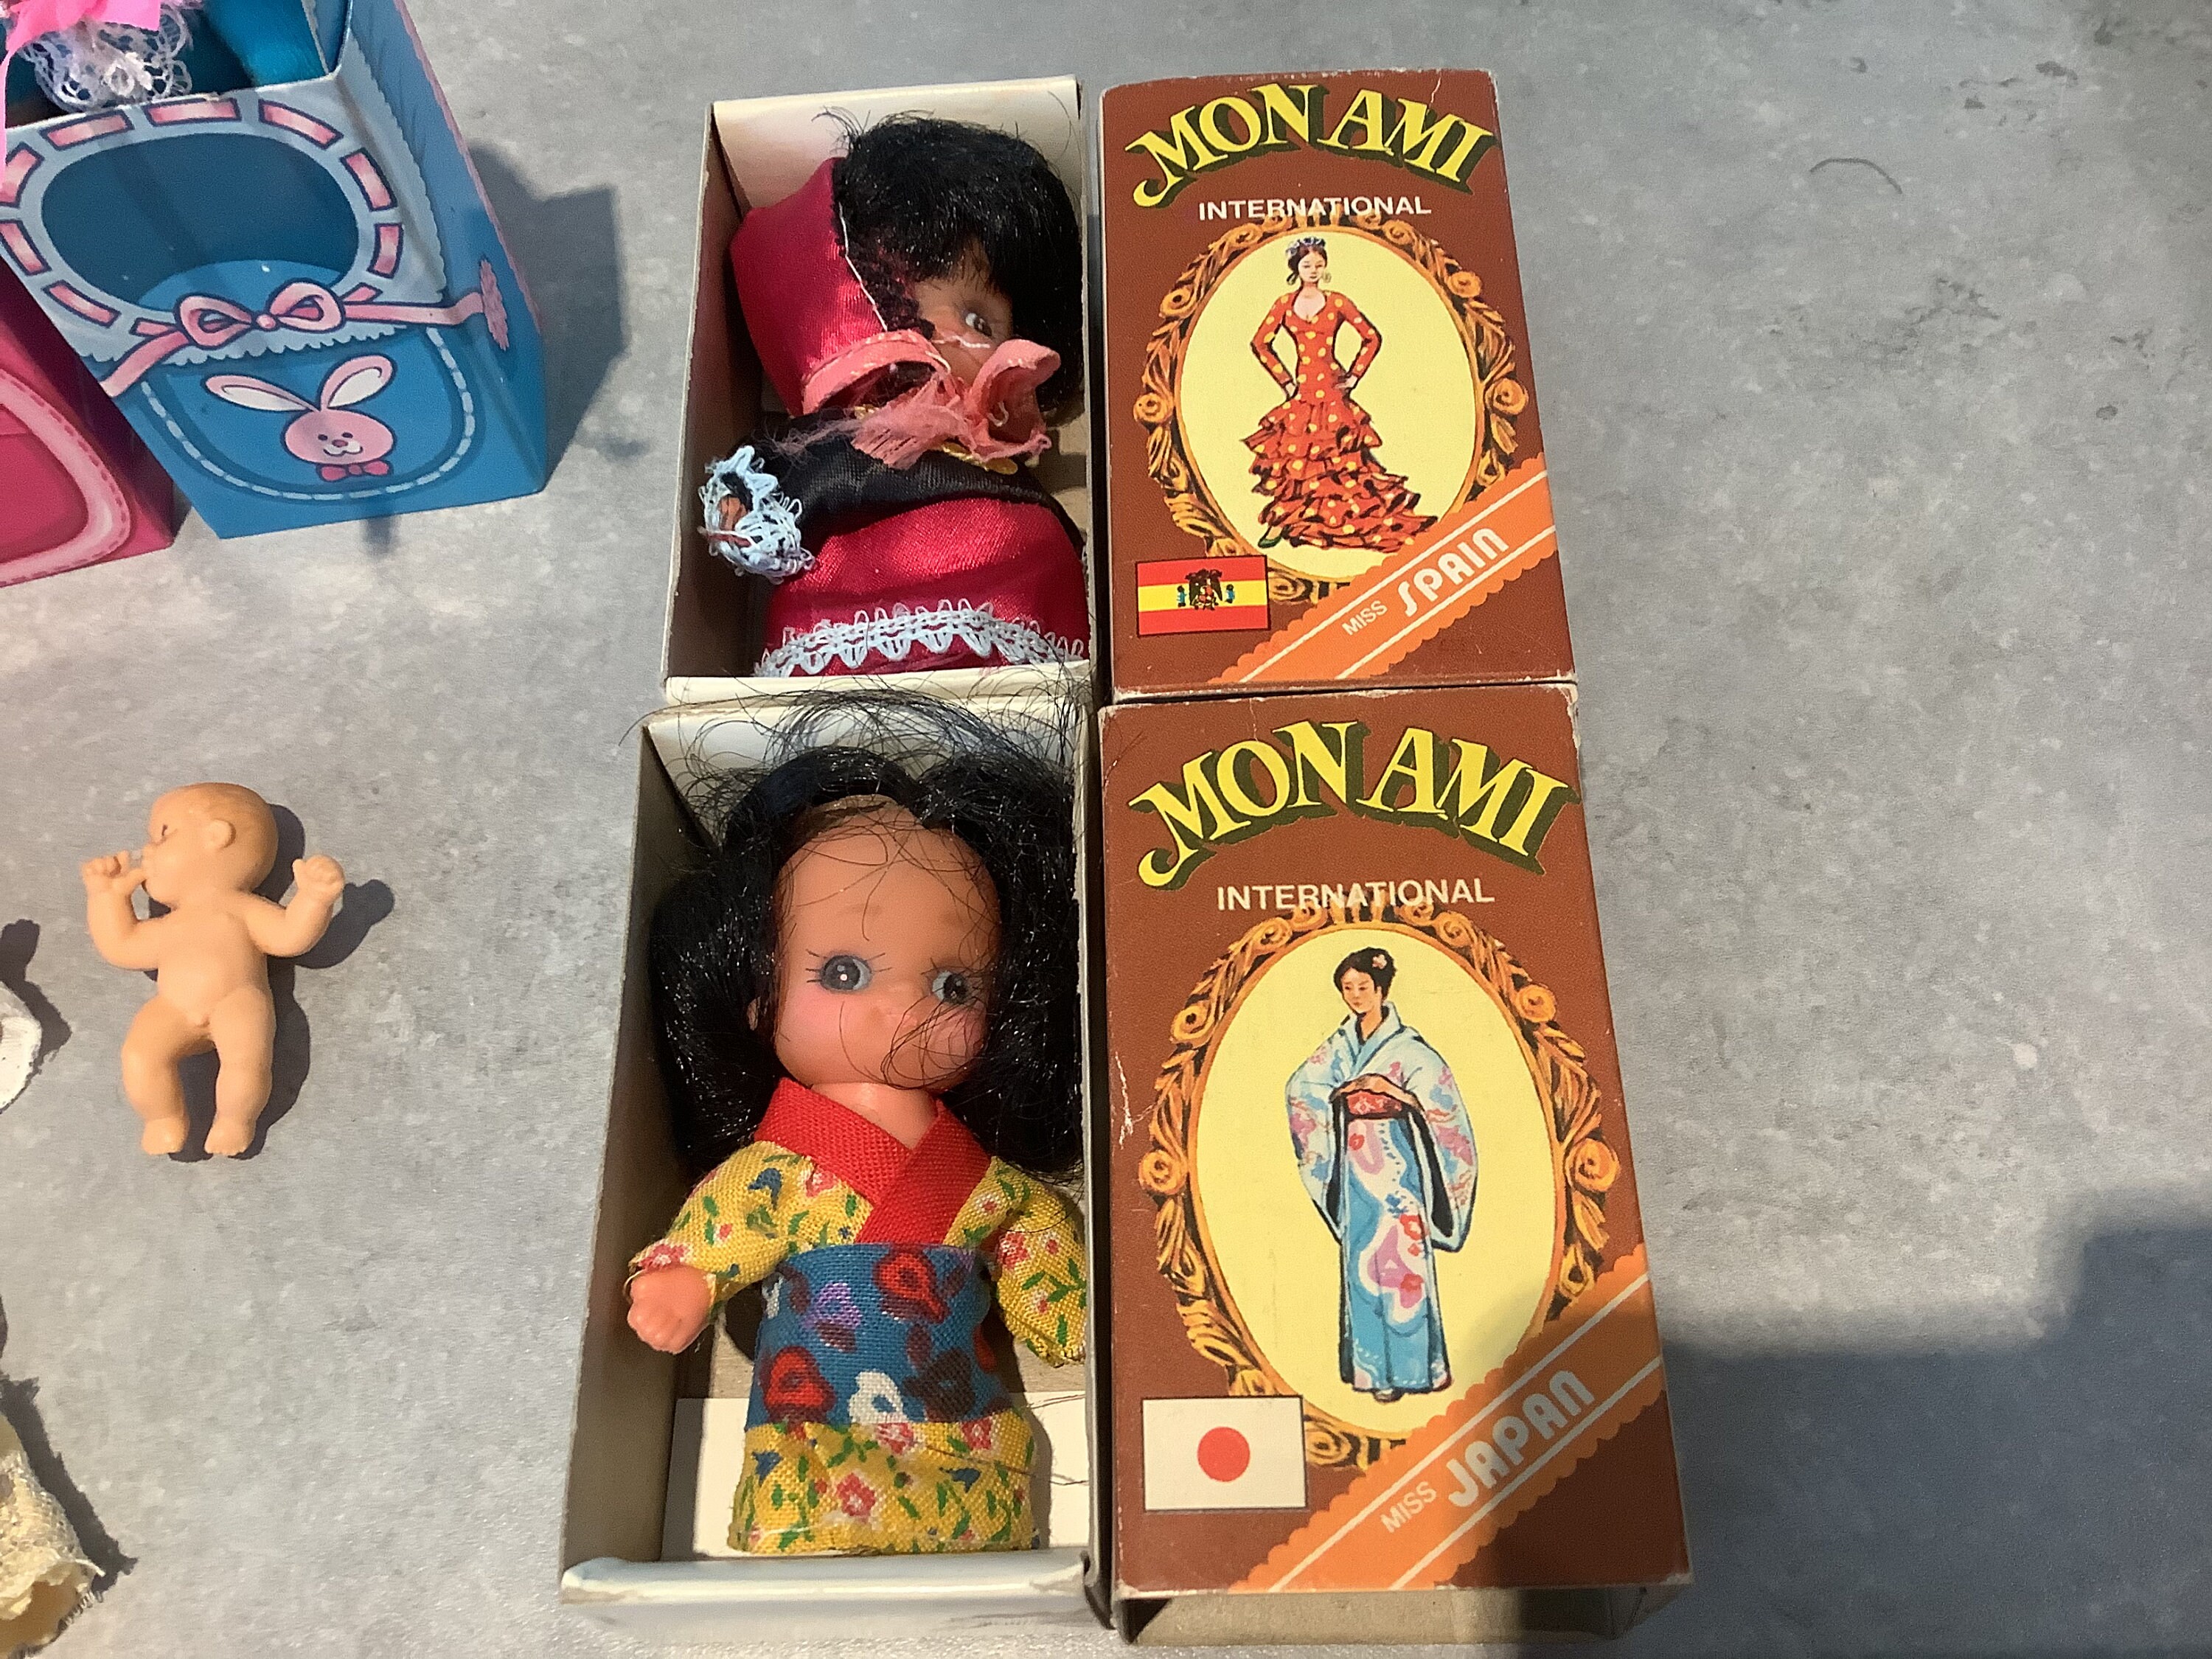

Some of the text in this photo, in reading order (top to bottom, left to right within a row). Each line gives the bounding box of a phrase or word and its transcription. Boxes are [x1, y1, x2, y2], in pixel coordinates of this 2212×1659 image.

[1126, 83, 1495, 207] MON AMI
[1198, 195, 1432, 221] INTERNATIONAL
[1340, 526, 1512, 636] MISS SPAIN
[1128, 720, 1571, 888] MON AMI
[1217, 877, 1495, 912] INTERNATIONAL
[1379, 1369, 1596, 1534] MISS JAPAN
